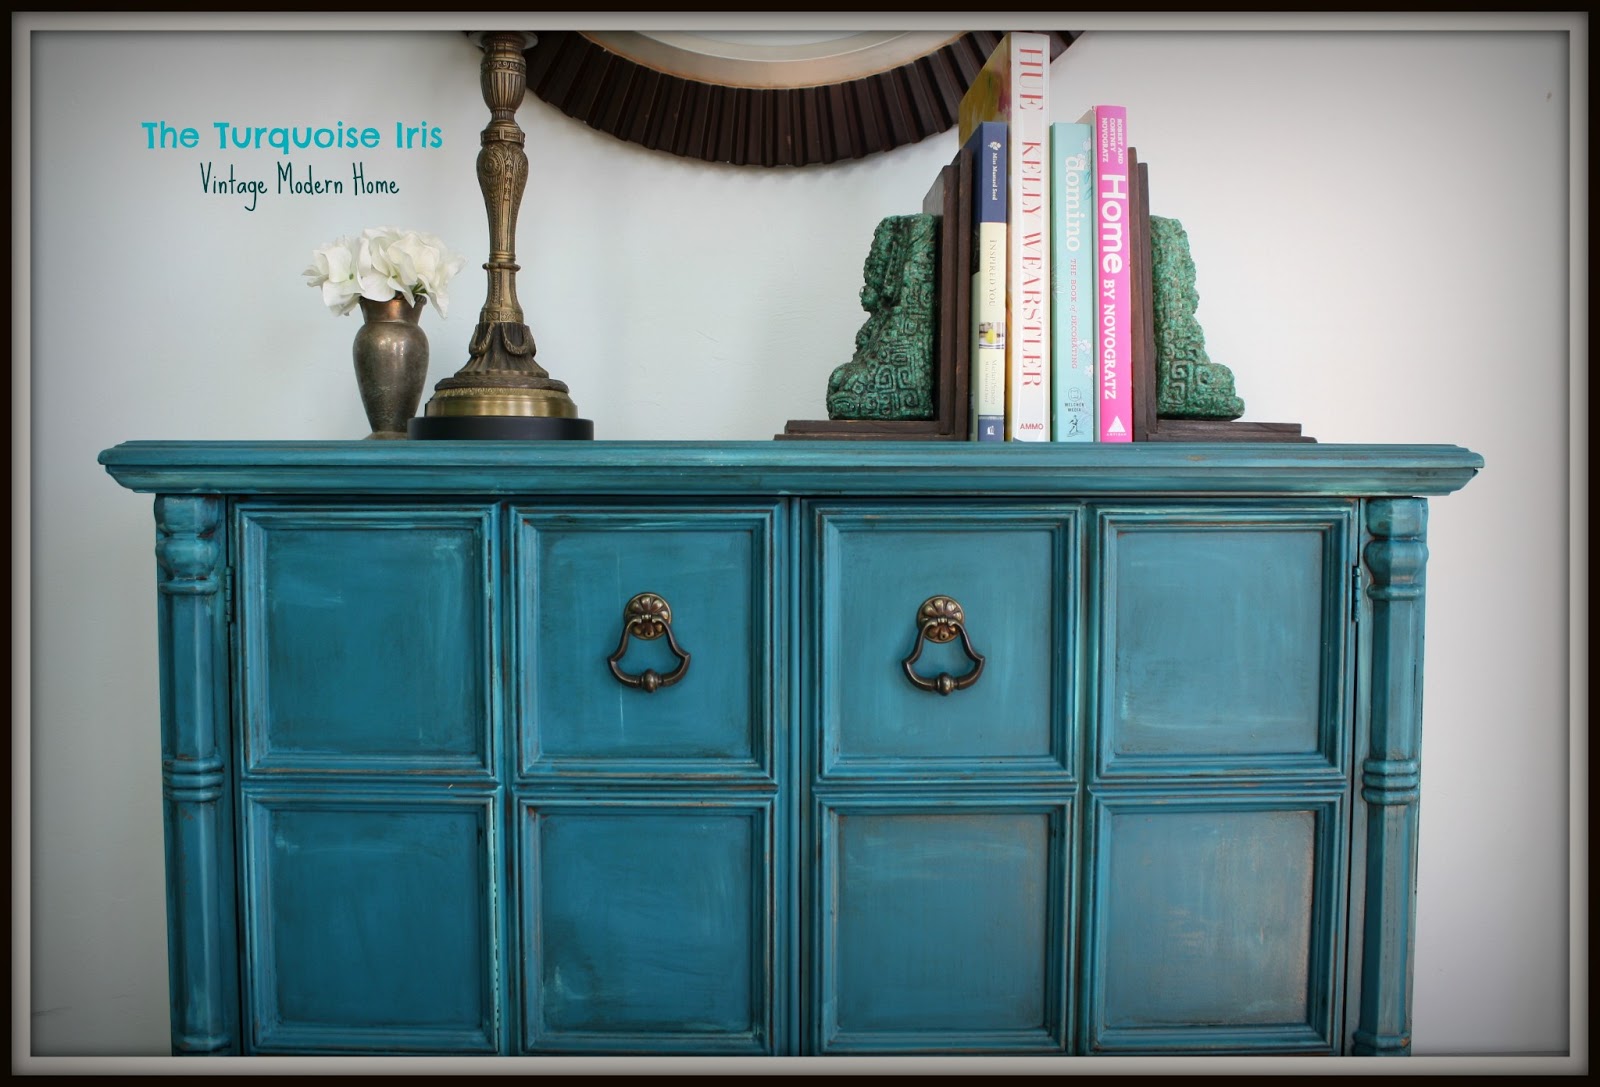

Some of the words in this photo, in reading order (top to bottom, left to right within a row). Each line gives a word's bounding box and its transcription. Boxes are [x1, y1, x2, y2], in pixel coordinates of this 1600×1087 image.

[1019, 48, 1044, 110] HUE
[1101, 117, 1109, 163] NOVOGRATZ
[1022, 141, 1042, 220] KELLY
[1065, 156, 1085, 252] domino
[1101, 173, 1126, 274] Home
[989, 239, 997, 285] INSPIRED
[1103, 279, 1116, 299] BY
[989, 287, 997, 307] YOU
[1022, 231, 1043, 386] WEARSTLER
[1070, 315, 1078, 369] DECORATING
[1104, 304, 1117, 400] NOVOGRATZ
